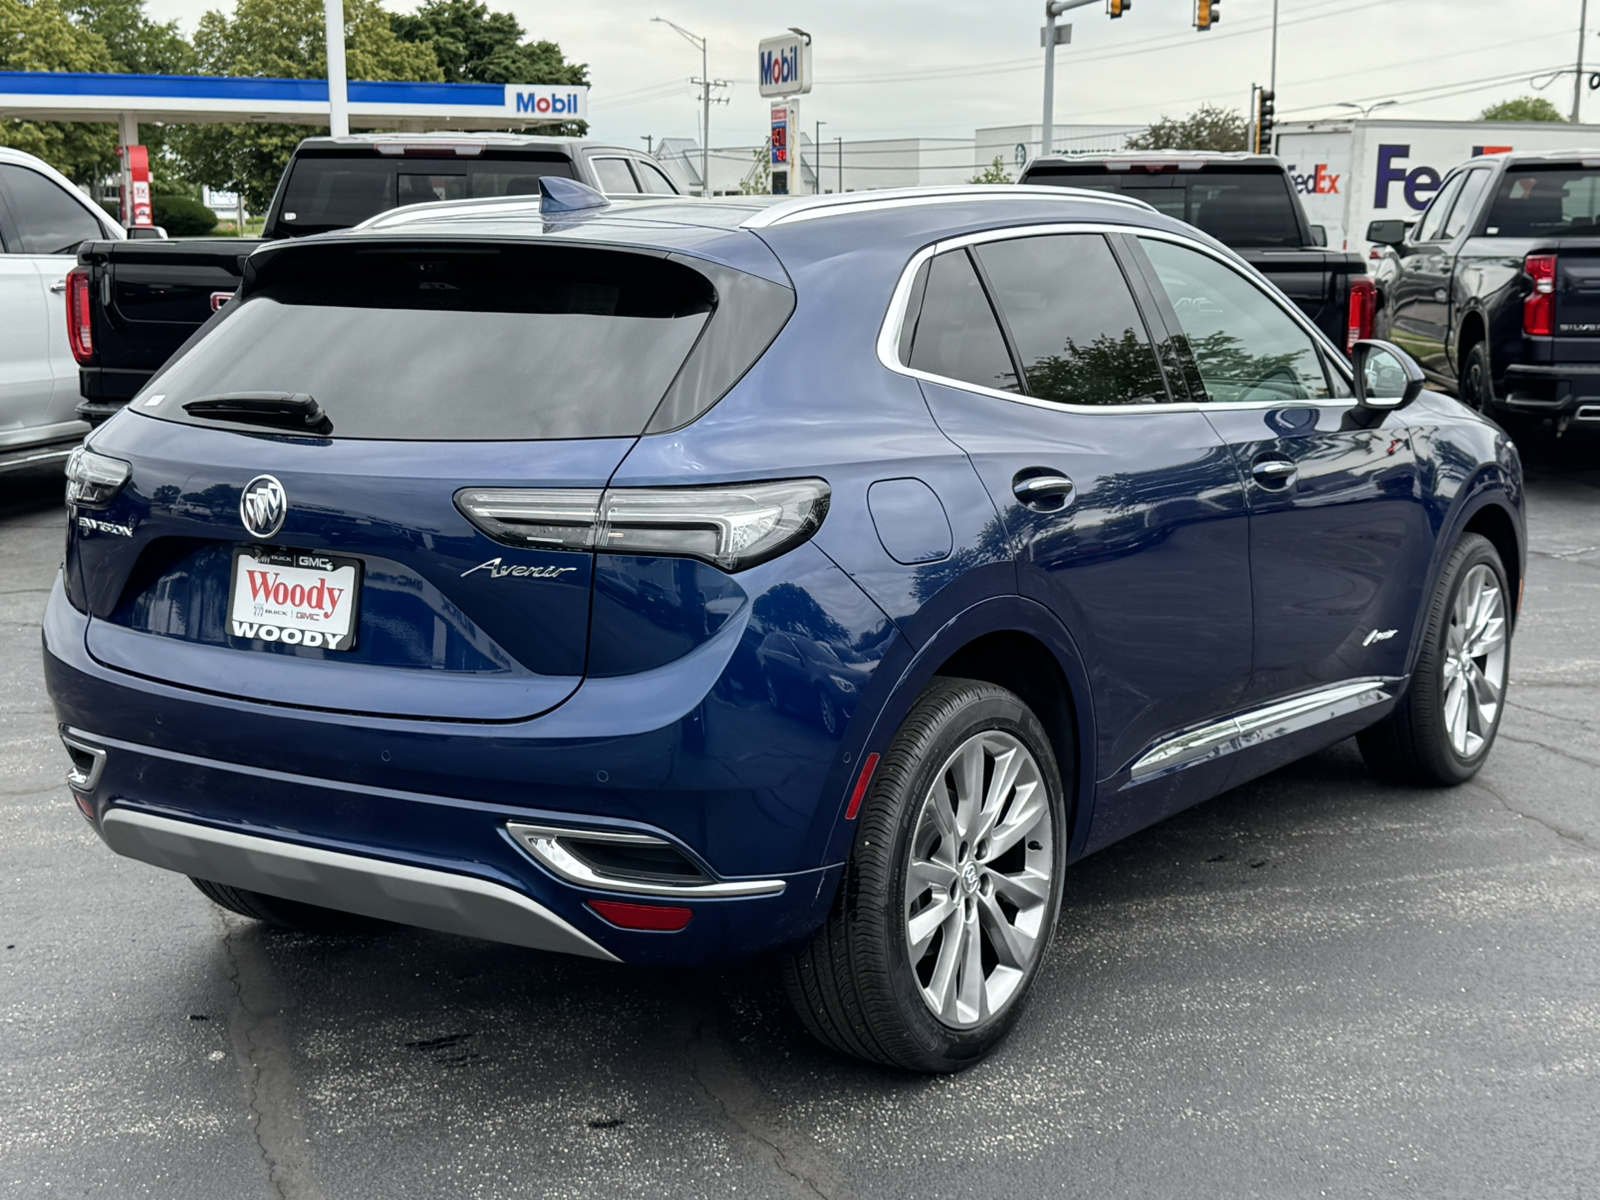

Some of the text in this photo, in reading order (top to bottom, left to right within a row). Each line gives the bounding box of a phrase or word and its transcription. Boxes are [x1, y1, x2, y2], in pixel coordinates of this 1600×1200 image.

[761, 45, 798, 86] Mobil
[516, 92, 578, 114] Mobil
[1559, 323, 1600, 332] SILVE
[299, 556, 331, 568] GMC
[460, 557, 578, 579] Avenir
[246, 569, 345, 620] Woody
[265, 609, 321, 622] BUICK GMC
[231, 620, 345, 650] WOODY
